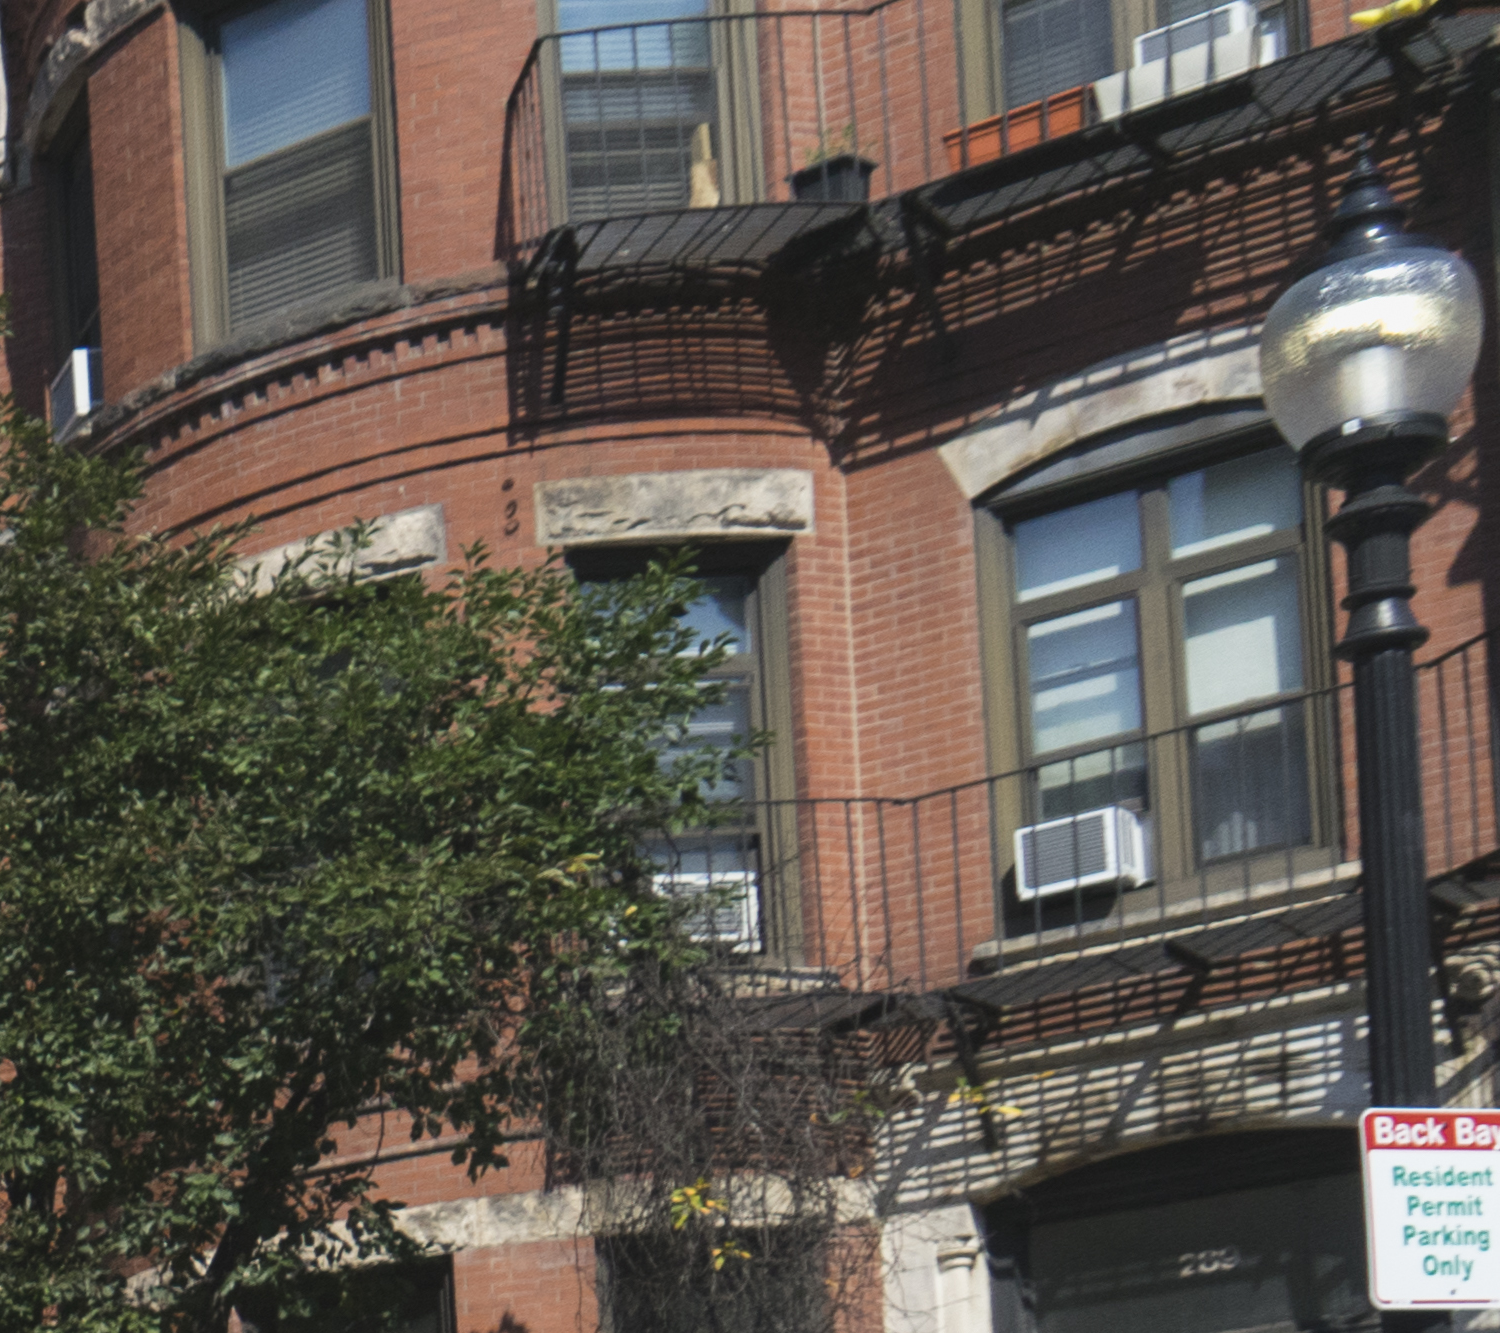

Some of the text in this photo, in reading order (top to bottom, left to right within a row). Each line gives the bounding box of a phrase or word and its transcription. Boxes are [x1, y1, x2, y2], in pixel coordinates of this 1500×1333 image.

[1373, 1115, 1448, 1146] Back
[1392, 1165, 1494, 1187] Resident
[1406, 1195, 1484, 1217] Permit
[1403, 1224, 1490, 1252] Parking
[1422, 1254, 1475, 1282] Only
